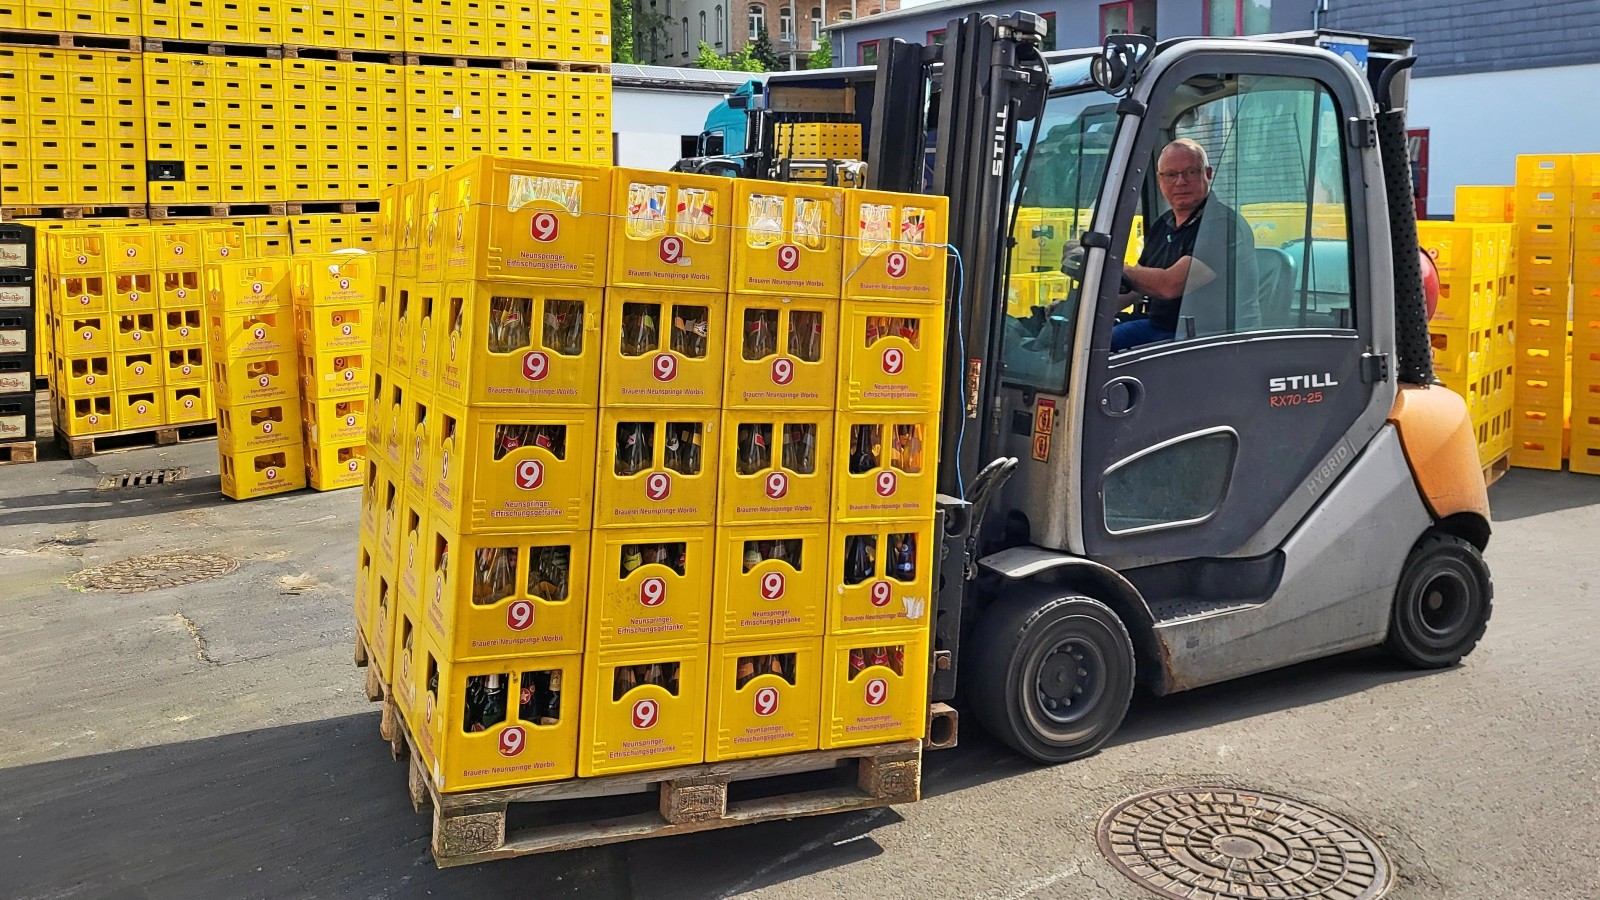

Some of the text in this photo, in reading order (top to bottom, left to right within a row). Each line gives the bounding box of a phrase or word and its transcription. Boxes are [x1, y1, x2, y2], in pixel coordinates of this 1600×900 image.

[992, 104, 1007, 176] STILL
[536, 214, 554, 240] 9
[520, 251, 565, 261] Neunspringer
[663, 238, 680, 262] 9
[780, 246, 797, 269] 9
[628, 269, 652, 278] Brauerei
[889, 254, 904, 277] 9
[253, 284, 261, 293] 9
[341, 279, 348, 289] 9
[255, 329, 264, 339] 9
[343, 325, 350, 335] 9
[527, 353, 546, 380] 9
[657, 356, 674, 380] 9
[774, 359, 790, 383] 9
[885, 350, 900, 373] 9
[260, 377, 268, 387] 9
[345, 371, 353, 380] 9
[1269, 373, 1338, 392] STILL
[556, 387, 578, 395] Worbis
[1270, 392, 1323, 407] RX70-25
[264, 422, 272, 433] 9
[347, 416, 355, 426] 9
[267, 469, 275, 479] 9
[349, 462, 357, 471] 9
[520, 461, 540, 488] 9
[1306, 446, 1348, 494] HYBRID
[650, 474, 667, 499] 9
[769, 474, 785, 497] 9
[879, 472, 894, 496] 9
[504, 500, 550, 510] Neunspringer
[644, 579, 662, 605] 9
[765, 574, 781, 598] 9
[874, 583, 889, 605] 9
[511, 602, 530, 629] 9
[630, 616, 673, 625] Neunspringer
[752, 609, 790, 617] Neunspringer
[472, 638, 499, 647] Brauerei
[541, 634, 563, 643] Worbis
[758, 690, 775, 714] 9
[868, 681, 884, 704] 9
[636, 701, 655, 727] 9
[746, 725, 784, 734] Neunspringer
[503, 728, 522, 754] 9
[622, 738, 664, 748] Neunspringer
[464, 768, 490, 777] Brauerei
[533, 761, 556, 769] Worbis
